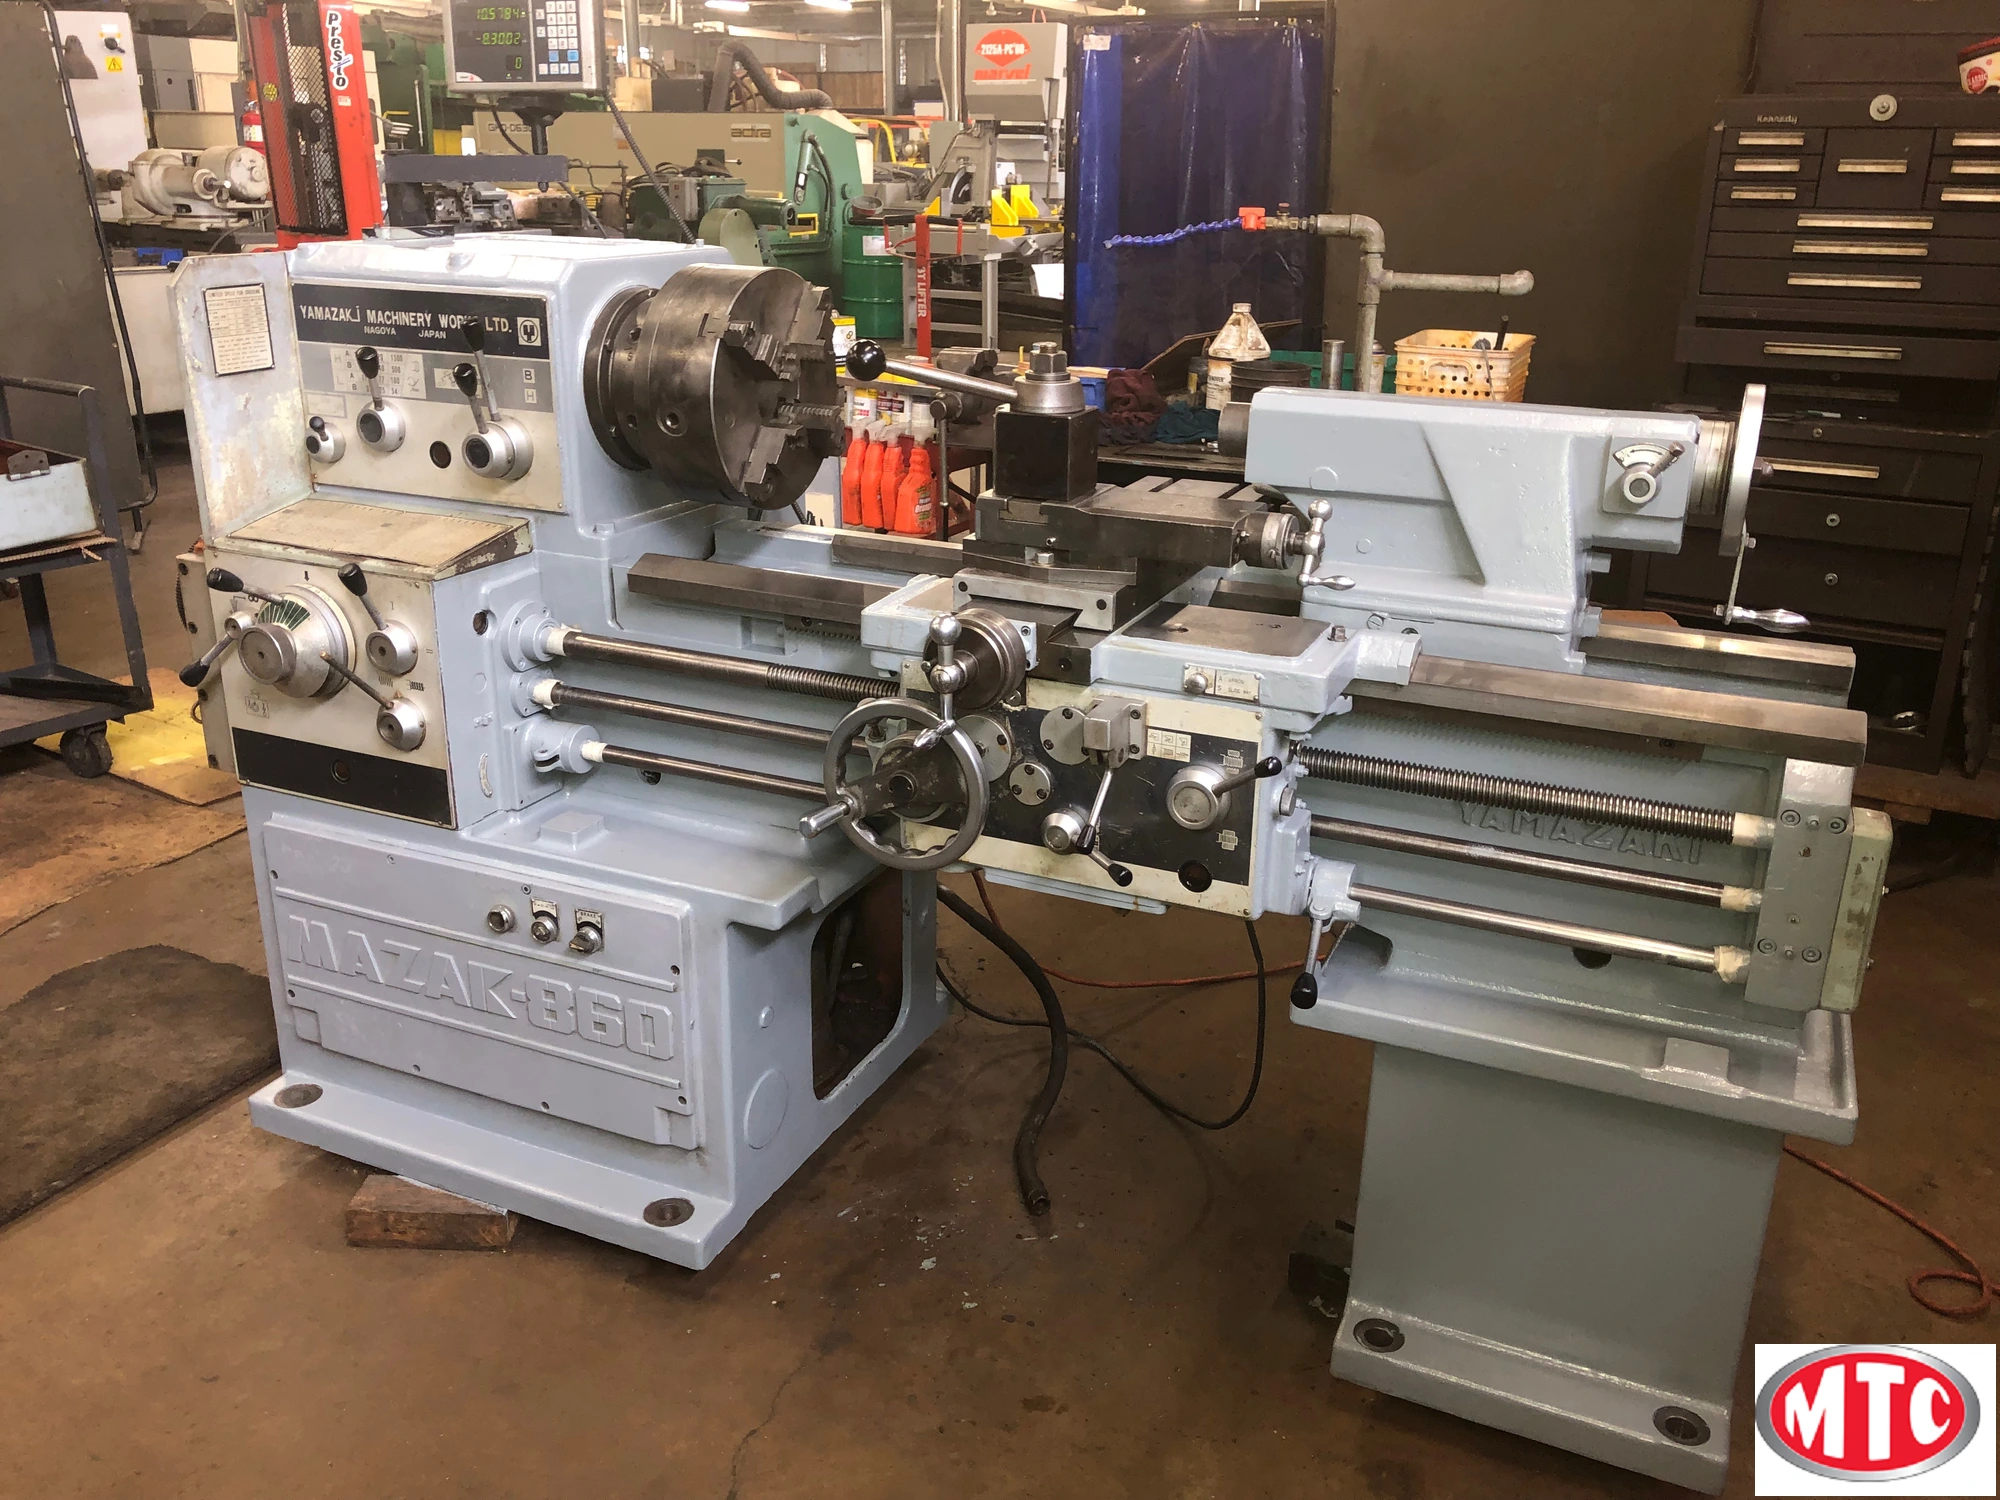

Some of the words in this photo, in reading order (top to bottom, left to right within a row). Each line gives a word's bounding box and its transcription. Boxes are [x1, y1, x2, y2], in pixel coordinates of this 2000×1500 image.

[475, 32, 521, 45] -8.3002
[327, 12, 348, 88] Presto
[514, 57, 522, 69] 0
[1756, 115, 1798, 124] Kennedy
[917, 266, 927, 280] 3T
[917, 282, 927, 318] LIFTER
[366, 309, 432, 328] MACHINERY
[485, 316, 513, 333] LTD.
[363, 325, 397, 336] NAGOYA
[418, 329, 447, 339] JAPAN
[580, 911, 597, 919] BRAKE
[287, 913, 675, 1062] MAZAK-860
